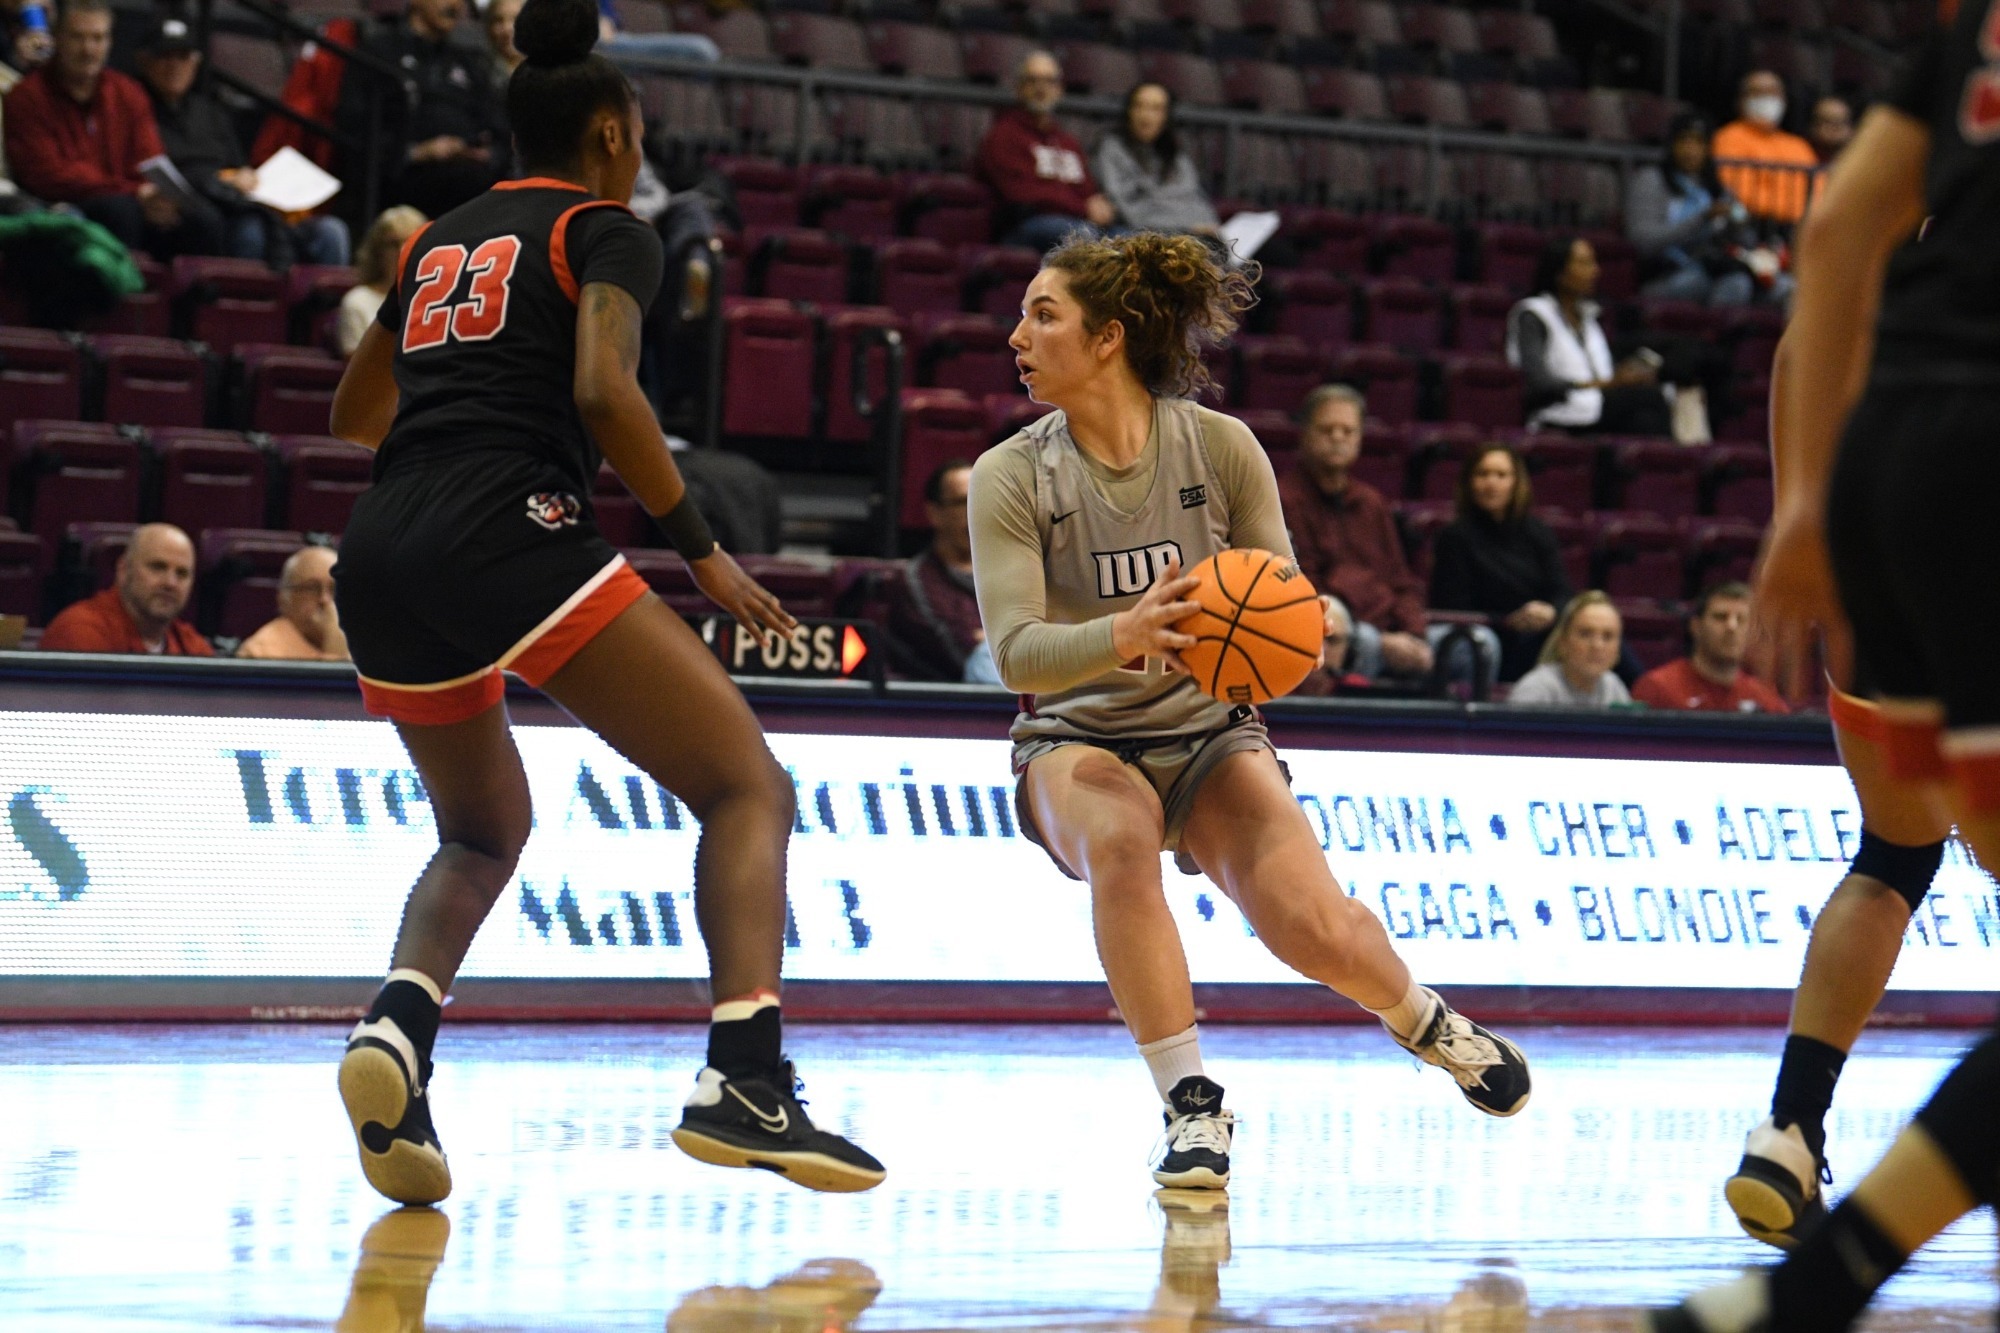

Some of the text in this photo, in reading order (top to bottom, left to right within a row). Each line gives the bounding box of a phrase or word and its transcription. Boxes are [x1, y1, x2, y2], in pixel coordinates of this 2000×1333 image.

[402, 235, 521, 353] 23
[1091, 540, 1184, 598] IUP
[1528, 801, 1656, 858] CHER
[1716, 805, 1860, 863] ADELE
[1380, 881, 1518, 940] GAGA
[1571, 885, 1782, 944] BLONDIE
